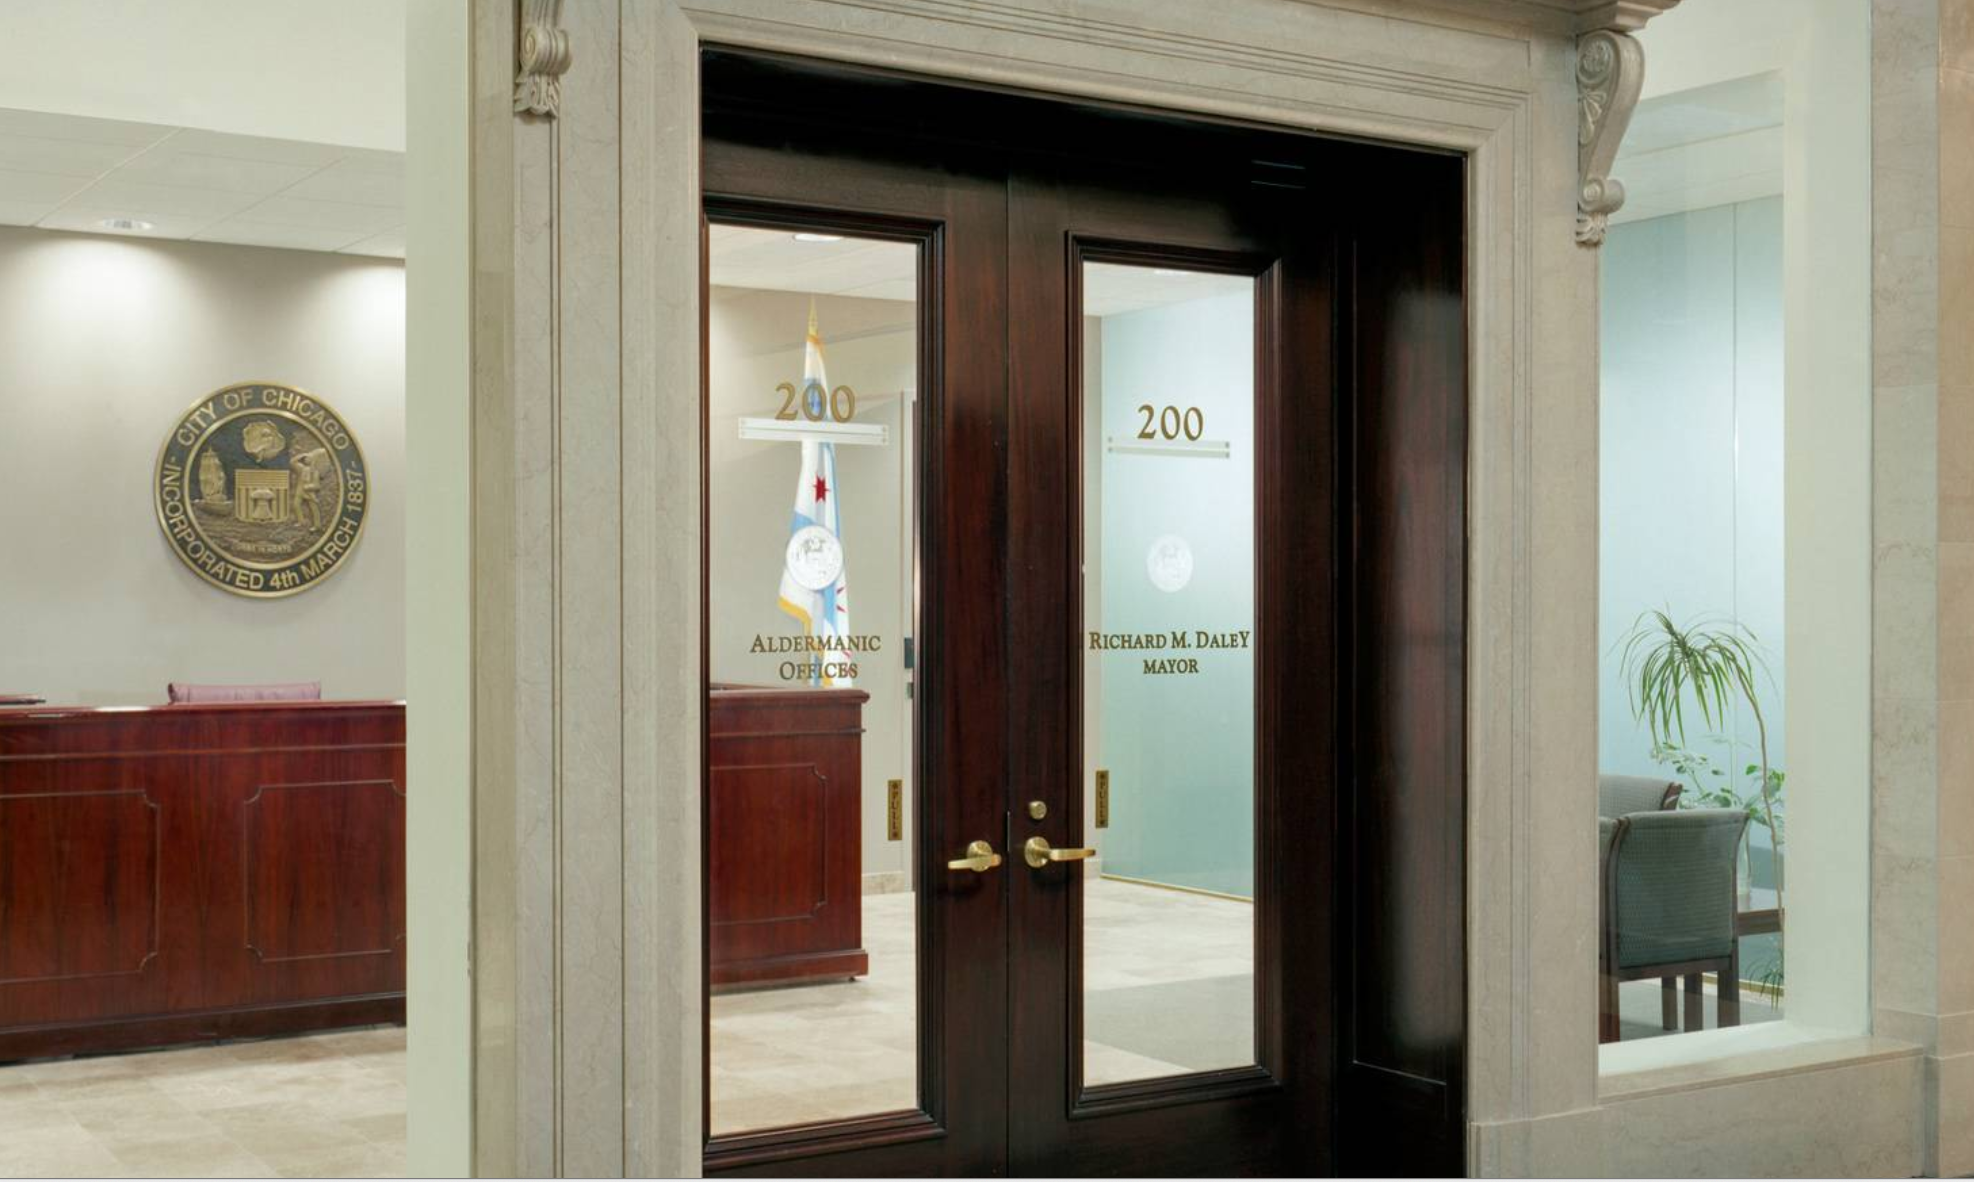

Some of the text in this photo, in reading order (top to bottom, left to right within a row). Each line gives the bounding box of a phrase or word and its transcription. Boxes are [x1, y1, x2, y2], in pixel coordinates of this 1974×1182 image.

[775, 382, 856, 424] 200
[176, 388, 349, 451] CITY OF CHICAGO
[1137, 404, 1204, 442] 200
[269, 571, 301, 590] 4th
[301, 517, 360, 577] MARCH
[750, 634, 882, 653] ALDERMANIC
[1088, 630, 1251, 650] RICHARD M. DALEY
[779, 661, 859, 680] OFFICES
[1142, 659, 1200, 675] MAYOR
